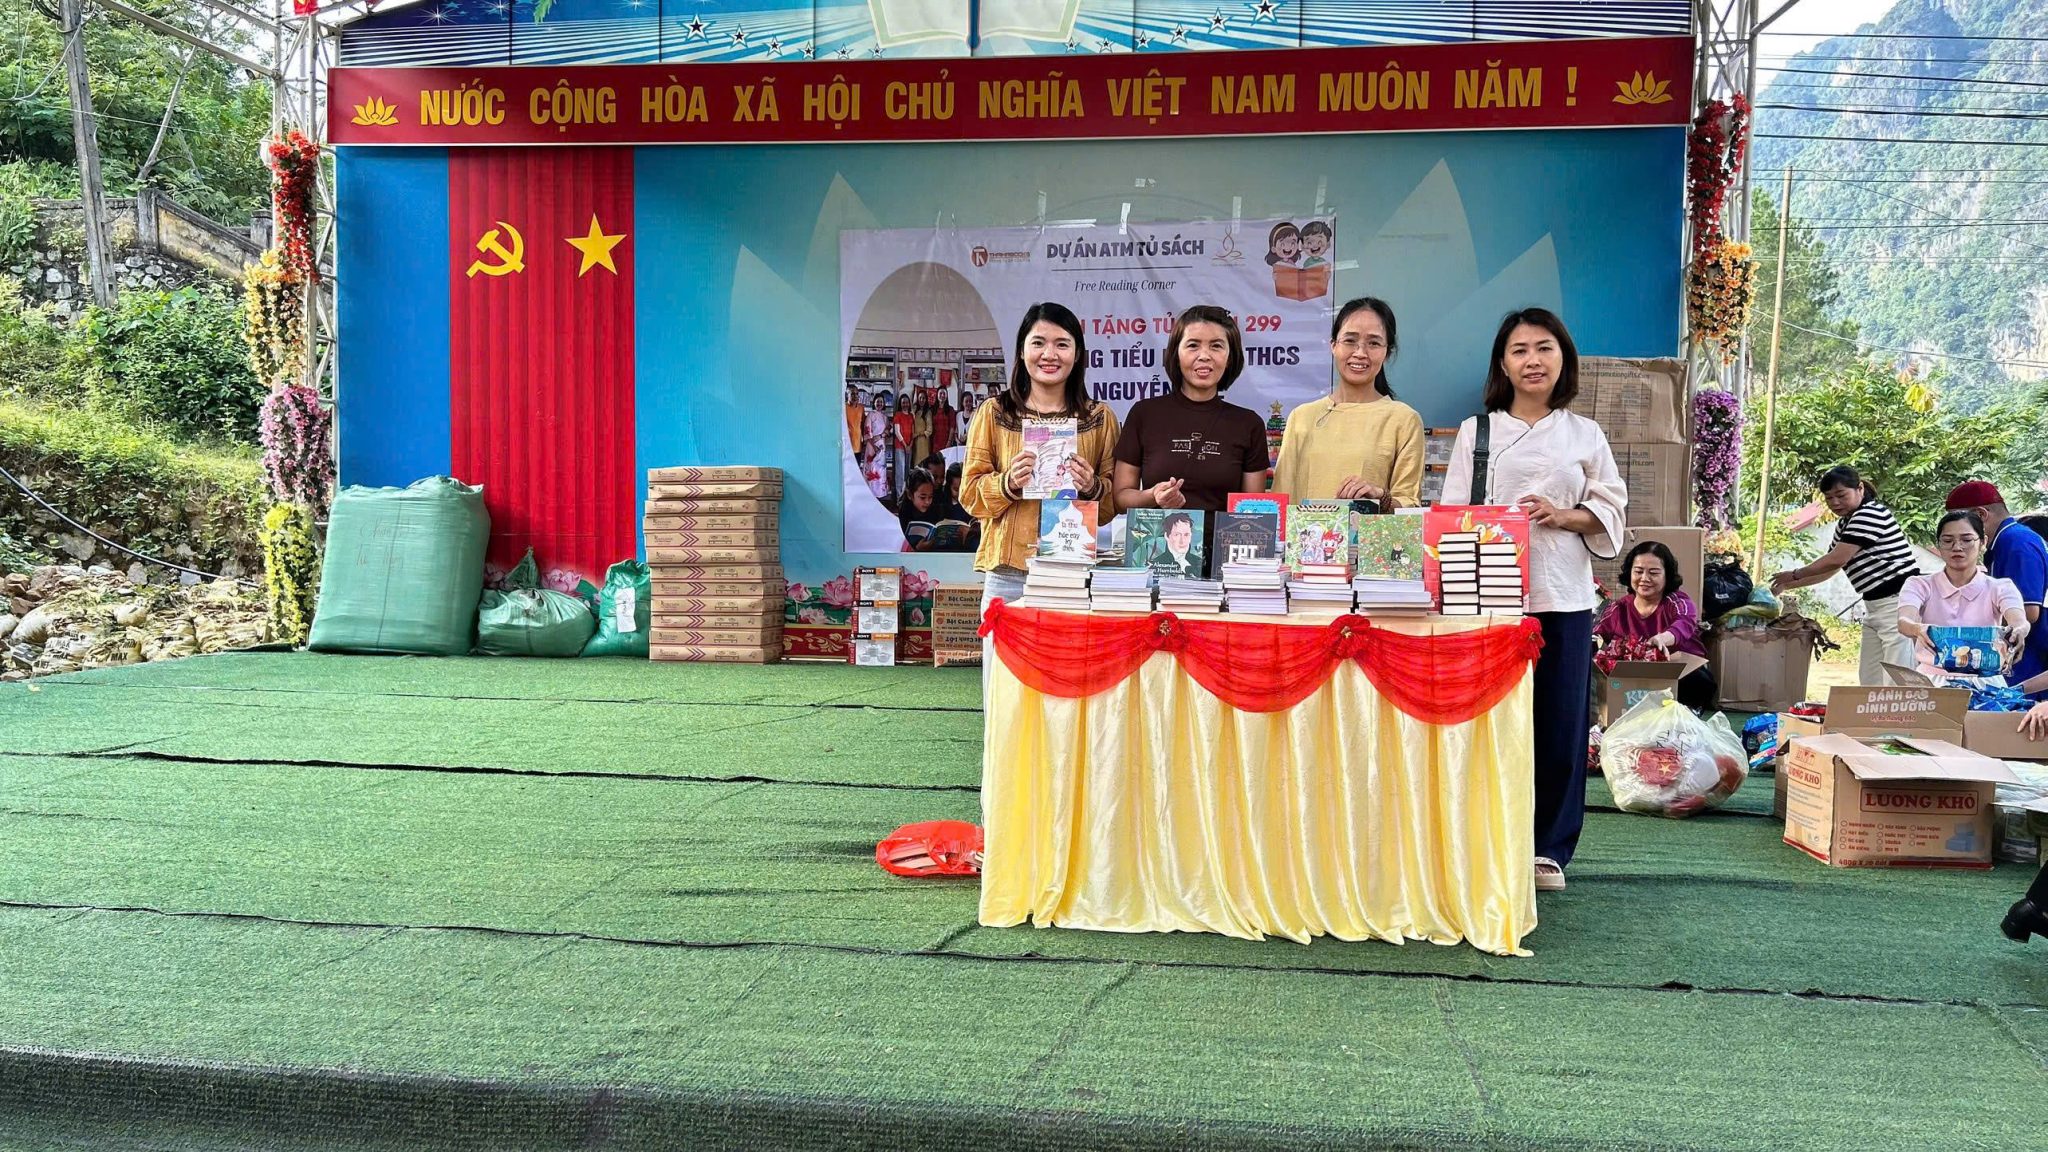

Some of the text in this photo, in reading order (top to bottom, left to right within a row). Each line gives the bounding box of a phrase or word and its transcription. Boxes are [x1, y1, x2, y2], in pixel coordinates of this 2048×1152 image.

[420, 60, 1577, 131] NƯỚC CỘNG HÒA XÃ HỘI CHỦ NGHĨA VIỆT NAM MUÔN NĂM !
[1046, 234, 1204, 263] DỰ ÁN ATM TỦ SÁCH
[1074, 279, 1176, 293] Free Reading Corner
[1092, 314, 1147, 339] TẶNG
[1245, 315, 1282, 332] 299
[1110, 341, 1155, 368] TIỂU
[1245, 346, 1300, 366] THCS
[1229, 544, 1258, 564] FPT
[1868, 688, 1902, 702] BÁNH
[1890, 700, 1937, 713] DƯỠNG
